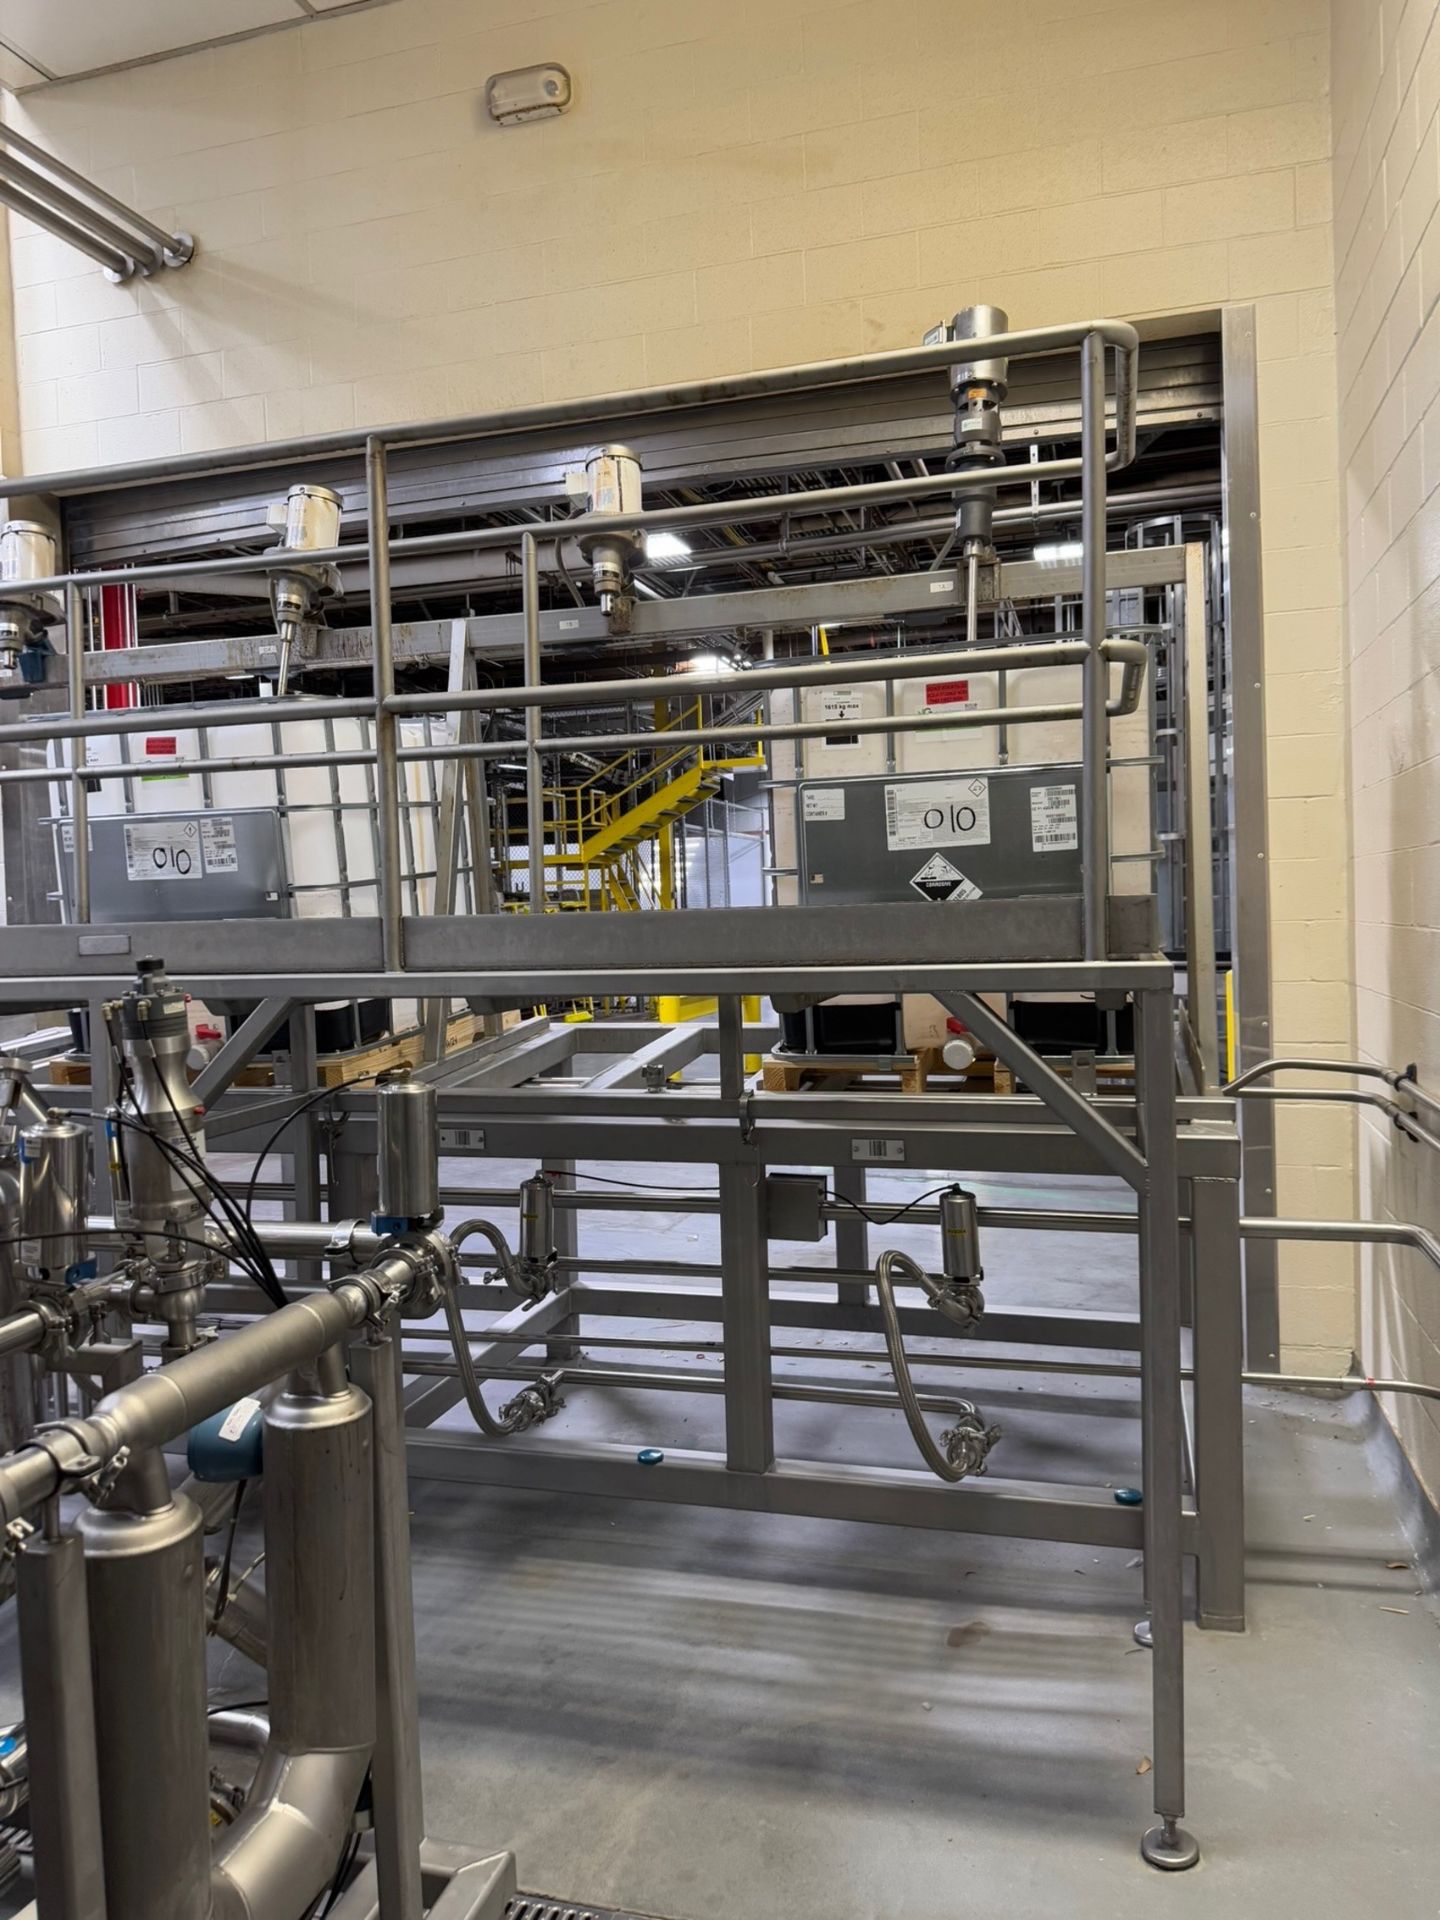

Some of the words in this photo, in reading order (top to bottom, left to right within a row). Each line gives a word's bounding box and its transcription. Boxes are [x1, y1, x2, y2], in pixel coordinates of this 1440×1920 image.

[923, 804, 976, 833] 010
[152, 846, 192, 875] 010
[925, 880, 952, 888] CORROSIVE
